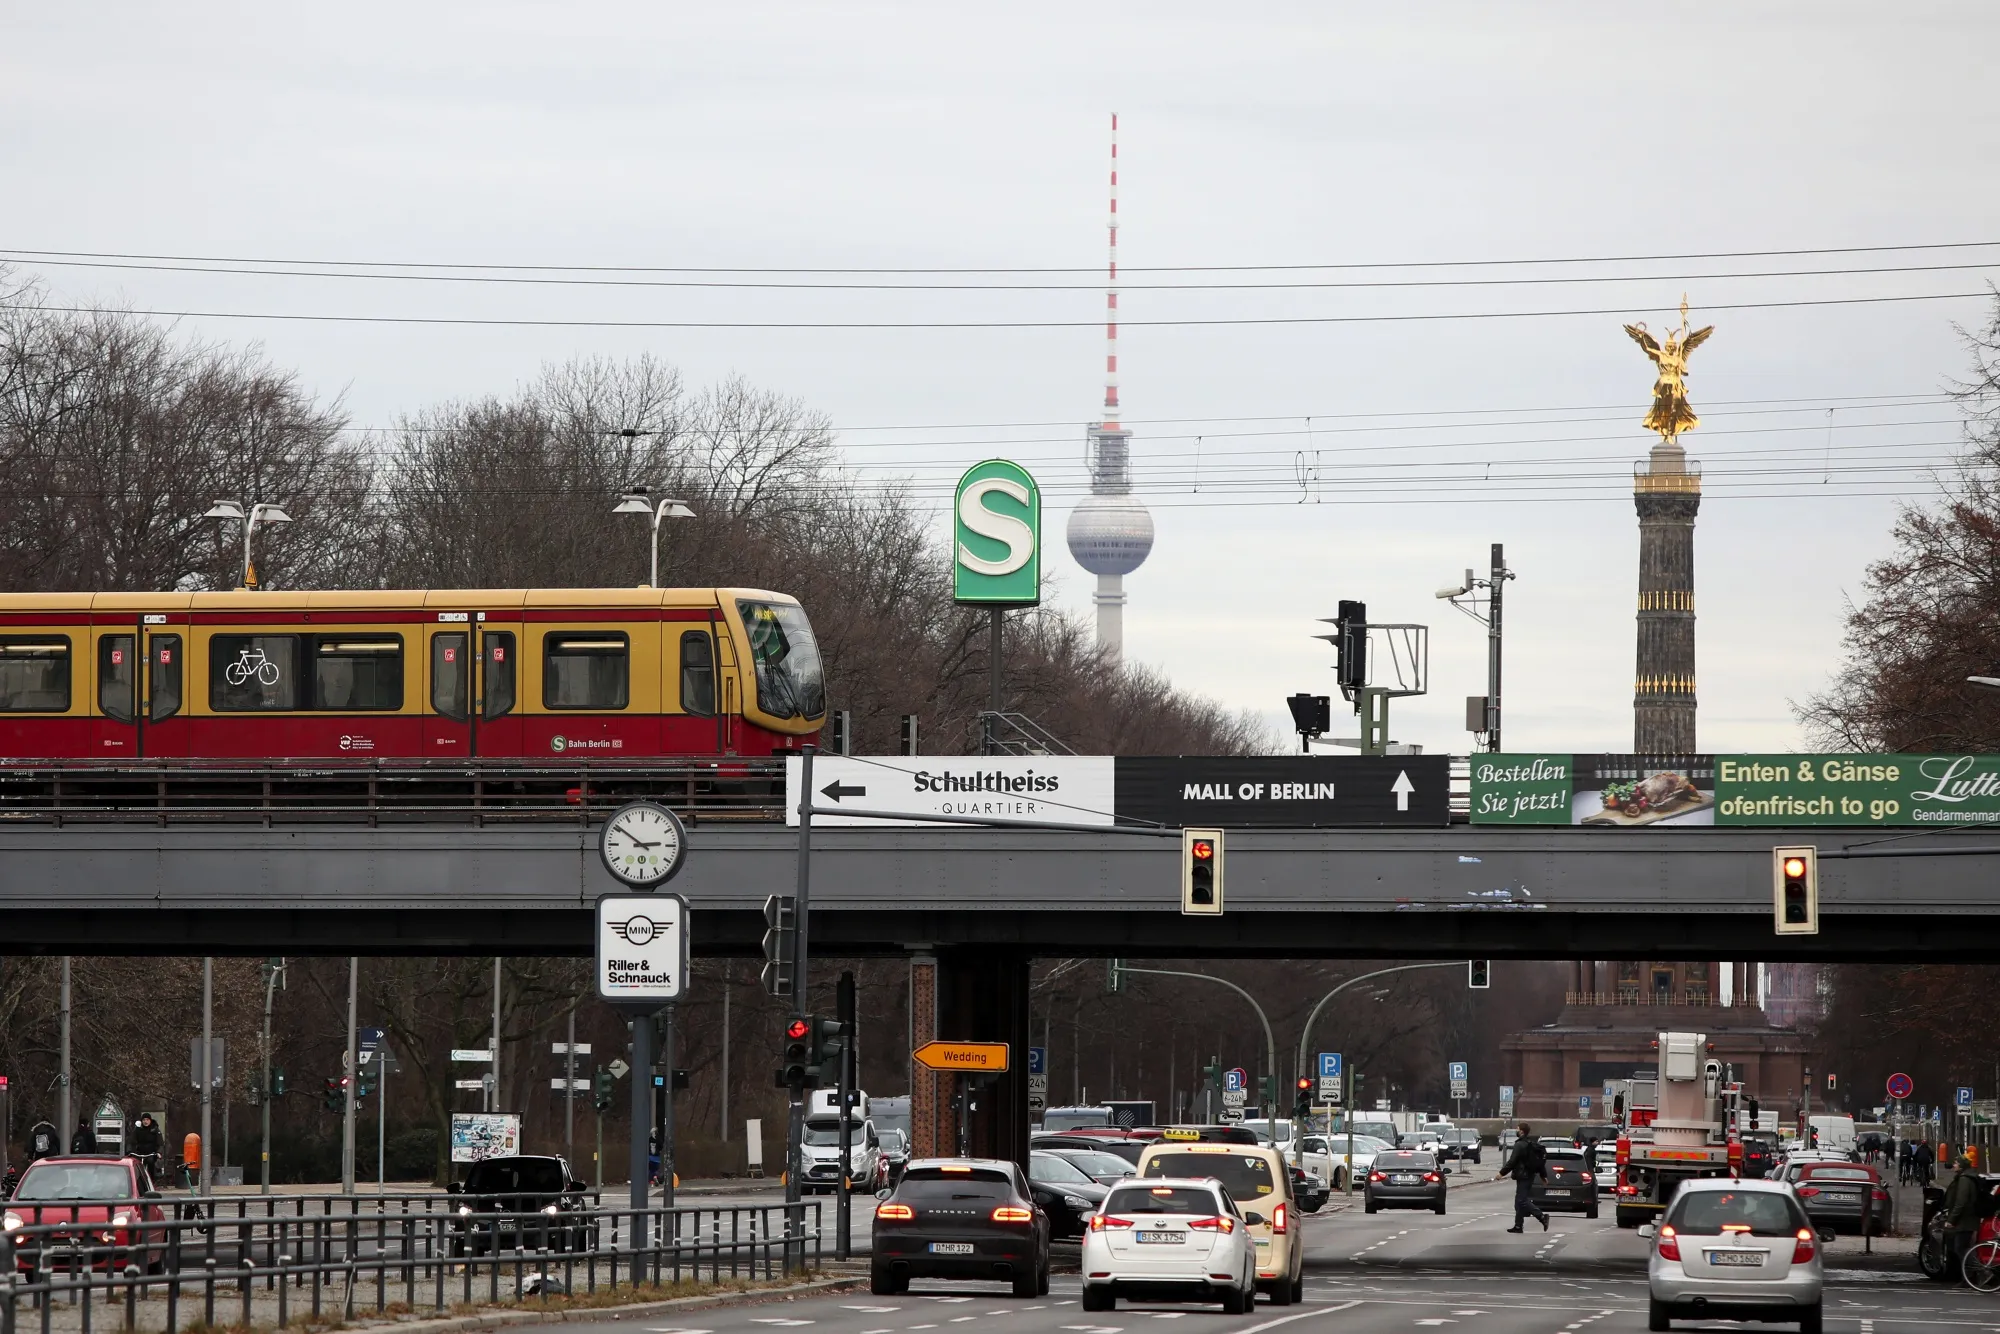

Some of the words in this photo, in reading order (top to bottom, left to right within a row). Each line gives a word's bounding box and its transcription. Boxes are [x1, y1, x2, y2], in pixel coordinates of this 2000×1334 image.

[959, 477, 1034, 576] S
[568, 740, 587, 748] Bahn
[588, 740, 610, 748] Berlin
[1477, 759, 1566, 783] Bestellen
[1720, 762, 1789, 782] Enten
[1797, 761, 1815, 782] &
[1822, 761, 1900, 782] Gänse
[914, 769, 1059, 793] Schultheiss
[1183, 783, 1233, 800] MALL
[1238, 783, 1264, 800] OF
[1270, 783, 1335, 800] BERLIN
[942, 803, 1036, 814] QUARTIER
[1477, 793, 1508, 814] Sie
[1509, 790, 1567, 818] jetzt!
[1720, 796, 1834, 816] ofenfrisch
[1841, 798, 1864, 816] to
[1869, 801, 1900, 820] go
[629, 926, 651, 934] MINI
[608, 972, 671, 983] Schnauck
[944, 1051, 987, 1064] Wedding
[1325, 1056, 1337, 1073] P
[1454, 1065, 1463, 1078] P
[1229, 1074, 1236, 1089] P
[1960, 1090, 1969, 1103] P
[957, 1245, 970, 1253] 122
